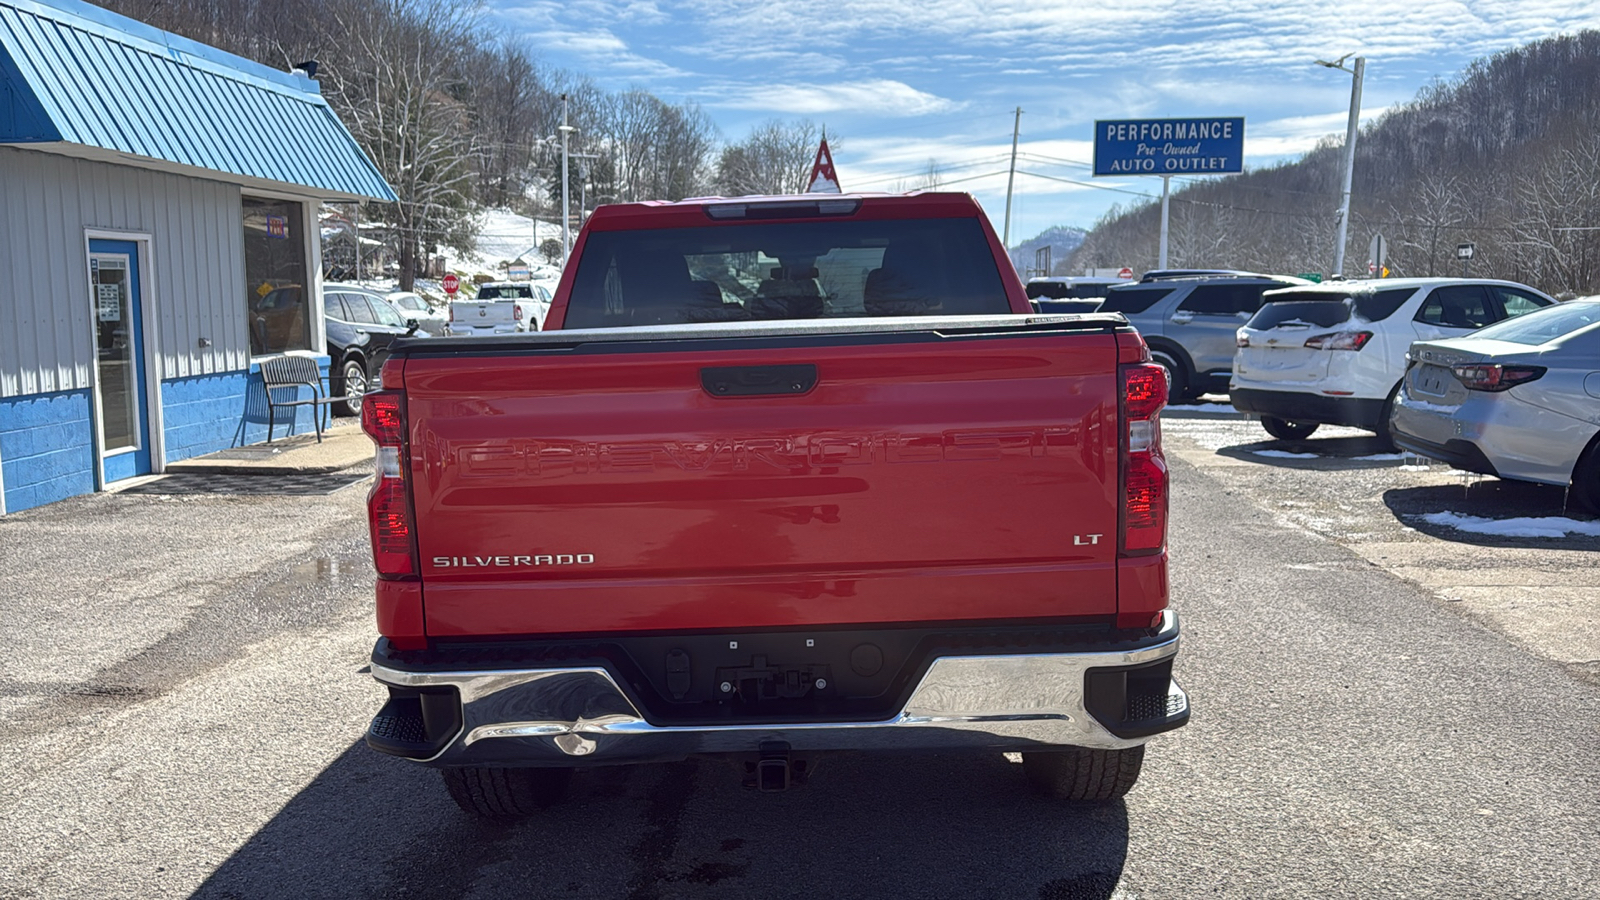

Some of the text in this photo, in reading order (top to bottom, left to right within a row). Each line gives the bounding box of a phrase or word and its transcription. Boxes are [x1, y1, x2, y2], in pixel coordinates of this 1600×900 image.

[1107, 122, 1232, 141] PERFORMANCE
[1136, 143, 1201, 156] Pre-Owned
[1110, 157, 1227, 171] AUTO OUTLET
[443, 280, 458, 289] STOP
[458, 429, 1075, 477] CHEVROLET
[1073, 533, 1104, 546] LT
[432, 553, 595, 568] SILVERADO
